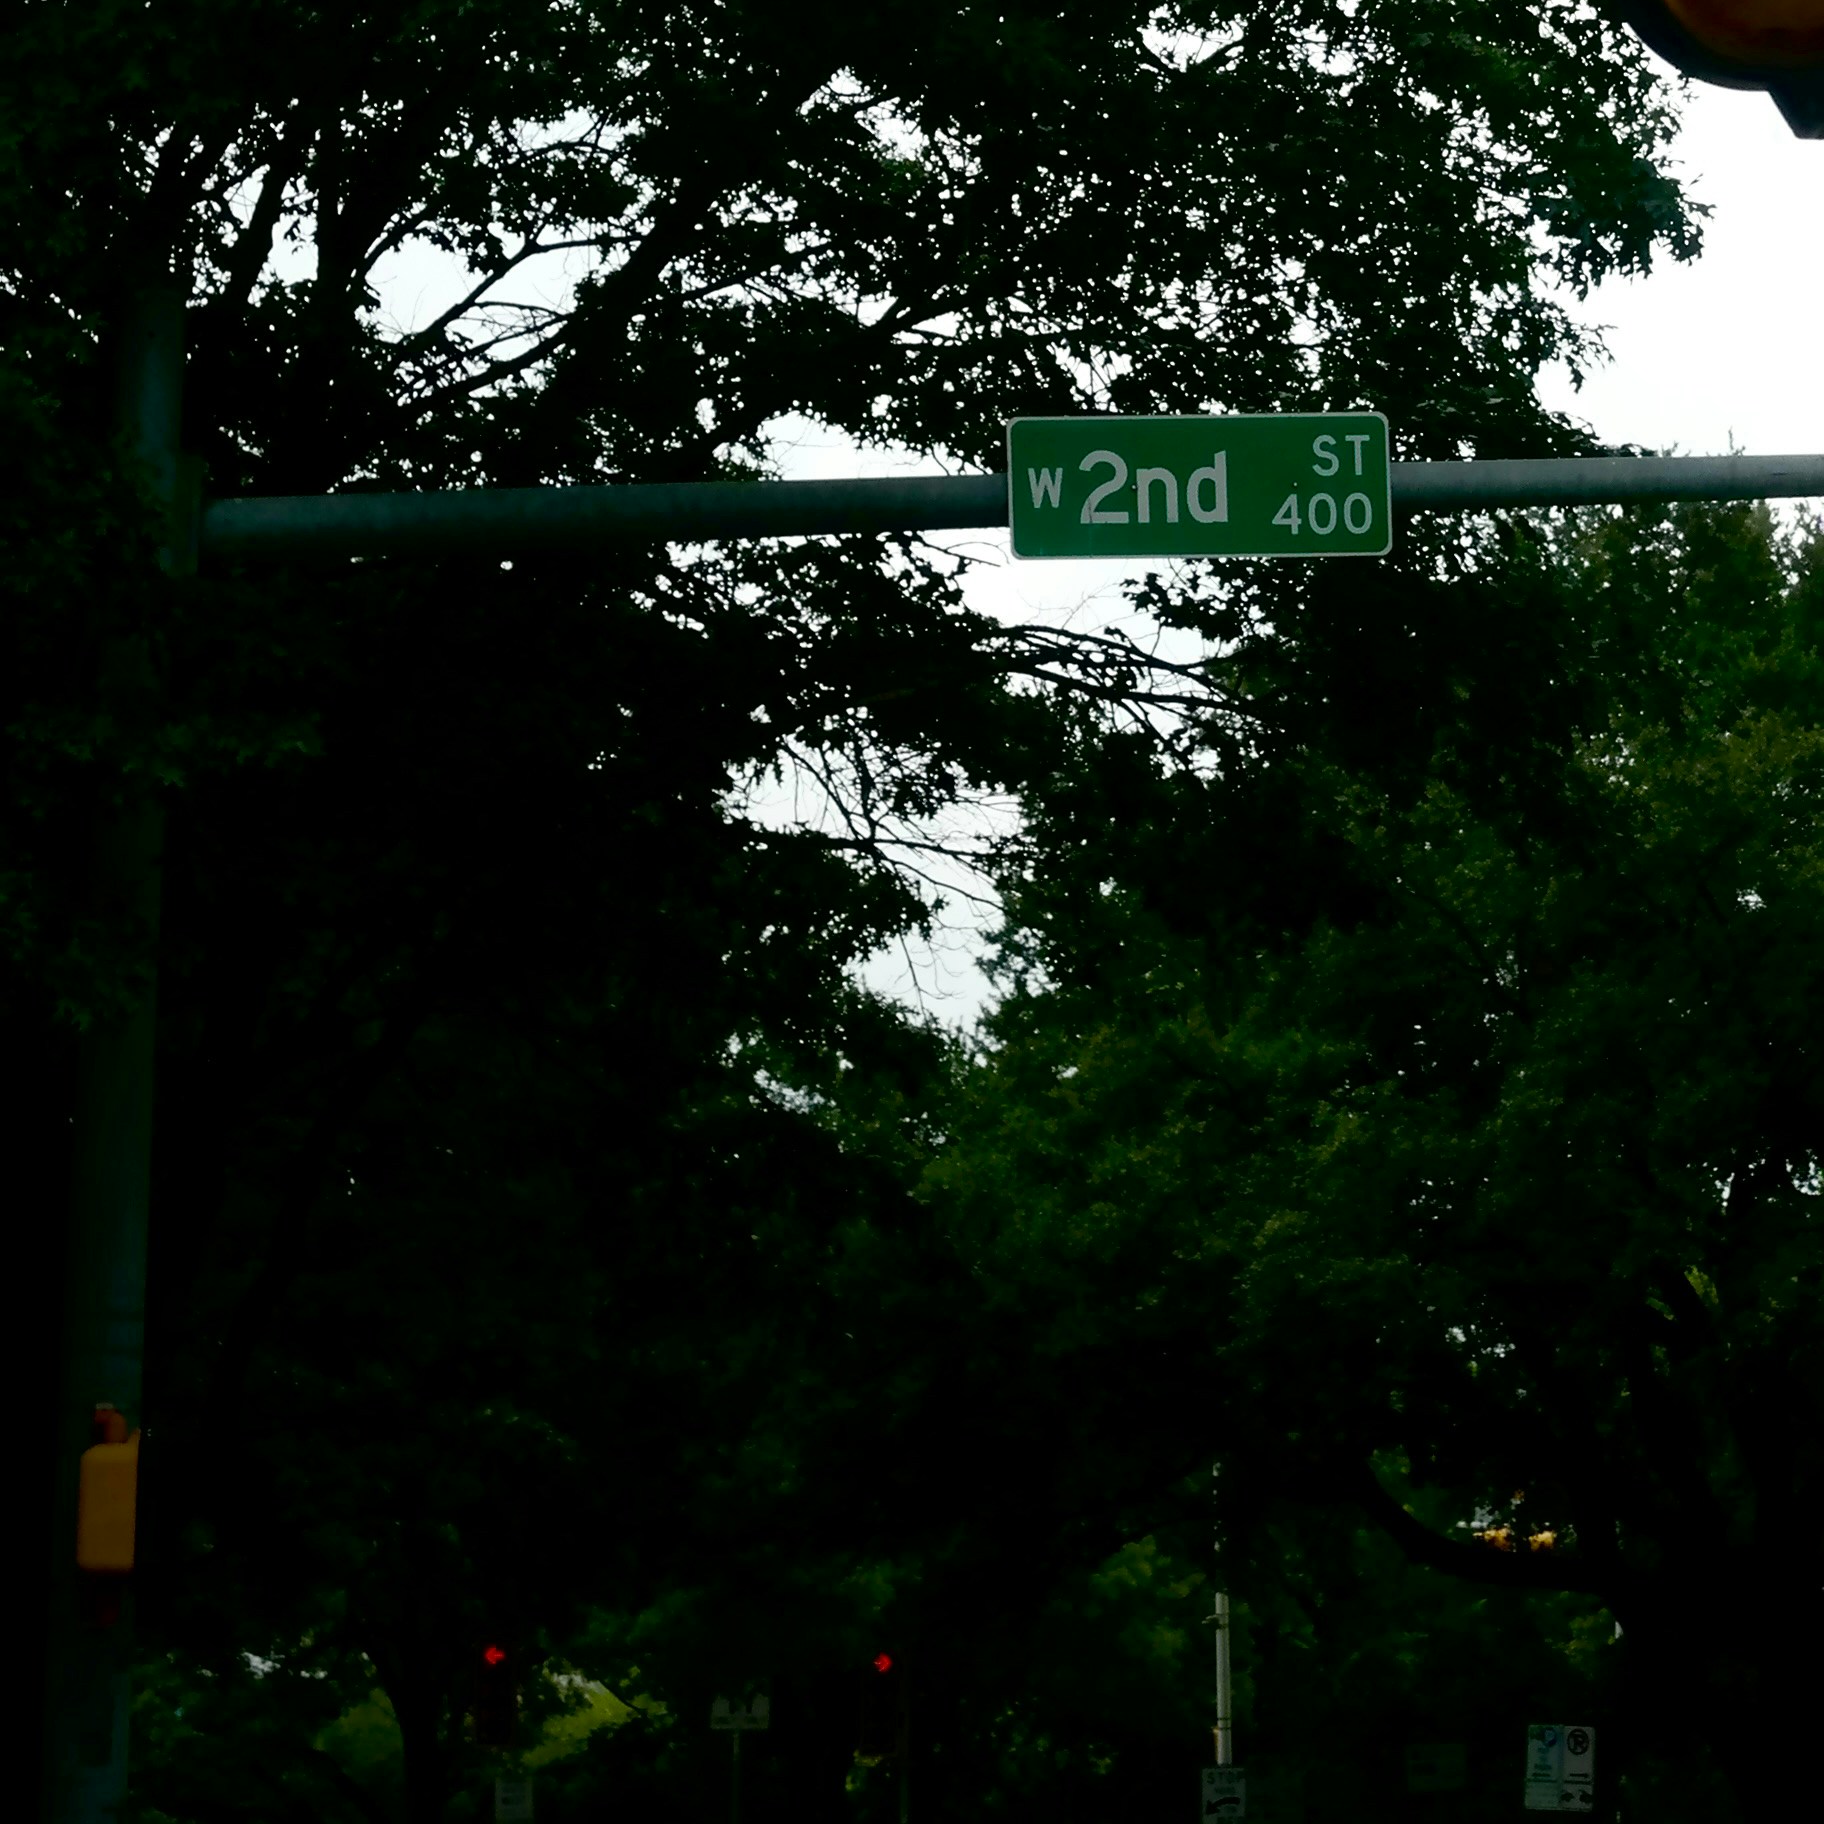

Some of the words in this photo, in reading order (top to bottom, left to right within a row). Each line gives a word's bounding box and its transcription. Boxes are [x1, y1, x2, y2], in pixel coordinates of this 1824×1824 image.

[1312, 434, 1370, 477] ST
[1028, 466, 1064, 509] W
[1078, 449, 1229, 524] 2nd
[1271, 492, 1373, 535] 400
